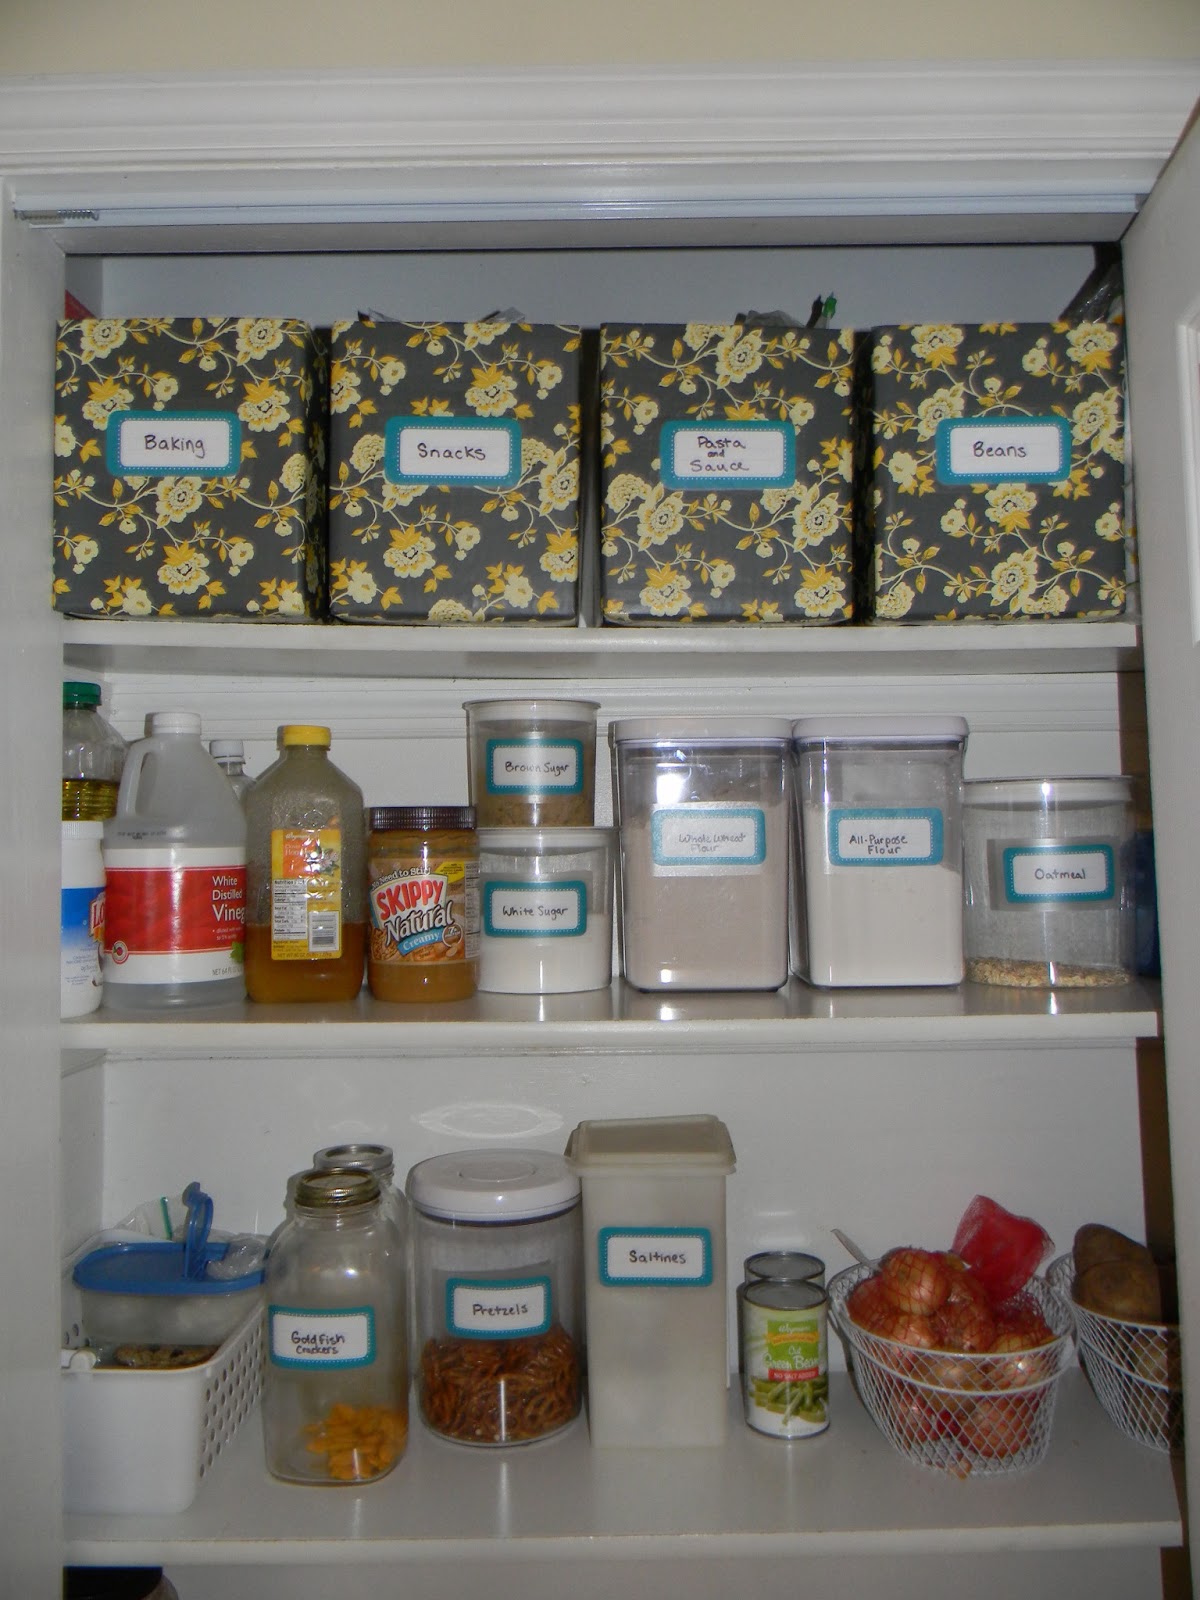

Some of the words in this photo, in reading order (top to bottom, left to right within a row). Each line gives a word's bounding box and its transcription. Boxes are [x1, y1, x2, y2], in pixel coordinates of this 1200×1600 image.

[144, 434, 205, 459] Baking
[697, 436, 746, 449] Pasta
[973, 441, 1027, 458] Beans
[417, 442, 486, 461] Snacks
[707, 449, 725, 458] and
[689, 459, 750, 472] Sauce
[504, 761, 541, 773] Brown
[543, 762, 571, 777] Sugar
[849, 834, 908, 848] All-Purpose
[868, 846, 901, 855] Flour
[399, 869, 409, 877] to
[1034, 868, 1086, 880] Oatmeal
[212, 876, 238, 886] White
[212, 889, 243, 901] Distilled
[376, 880, 444, 921] SKIPPY
[212, 903, 246, 924] Vineg
[502, 905, 534, 917] White
[537, 905, 569, 921] Sugar
[384, 900, 455, 946] Natural
[402, 932, 441, 951] Creamy
[628, 1250, 687, 1264] Saltines
[472, 1303, 529, 1316] Pretzels
